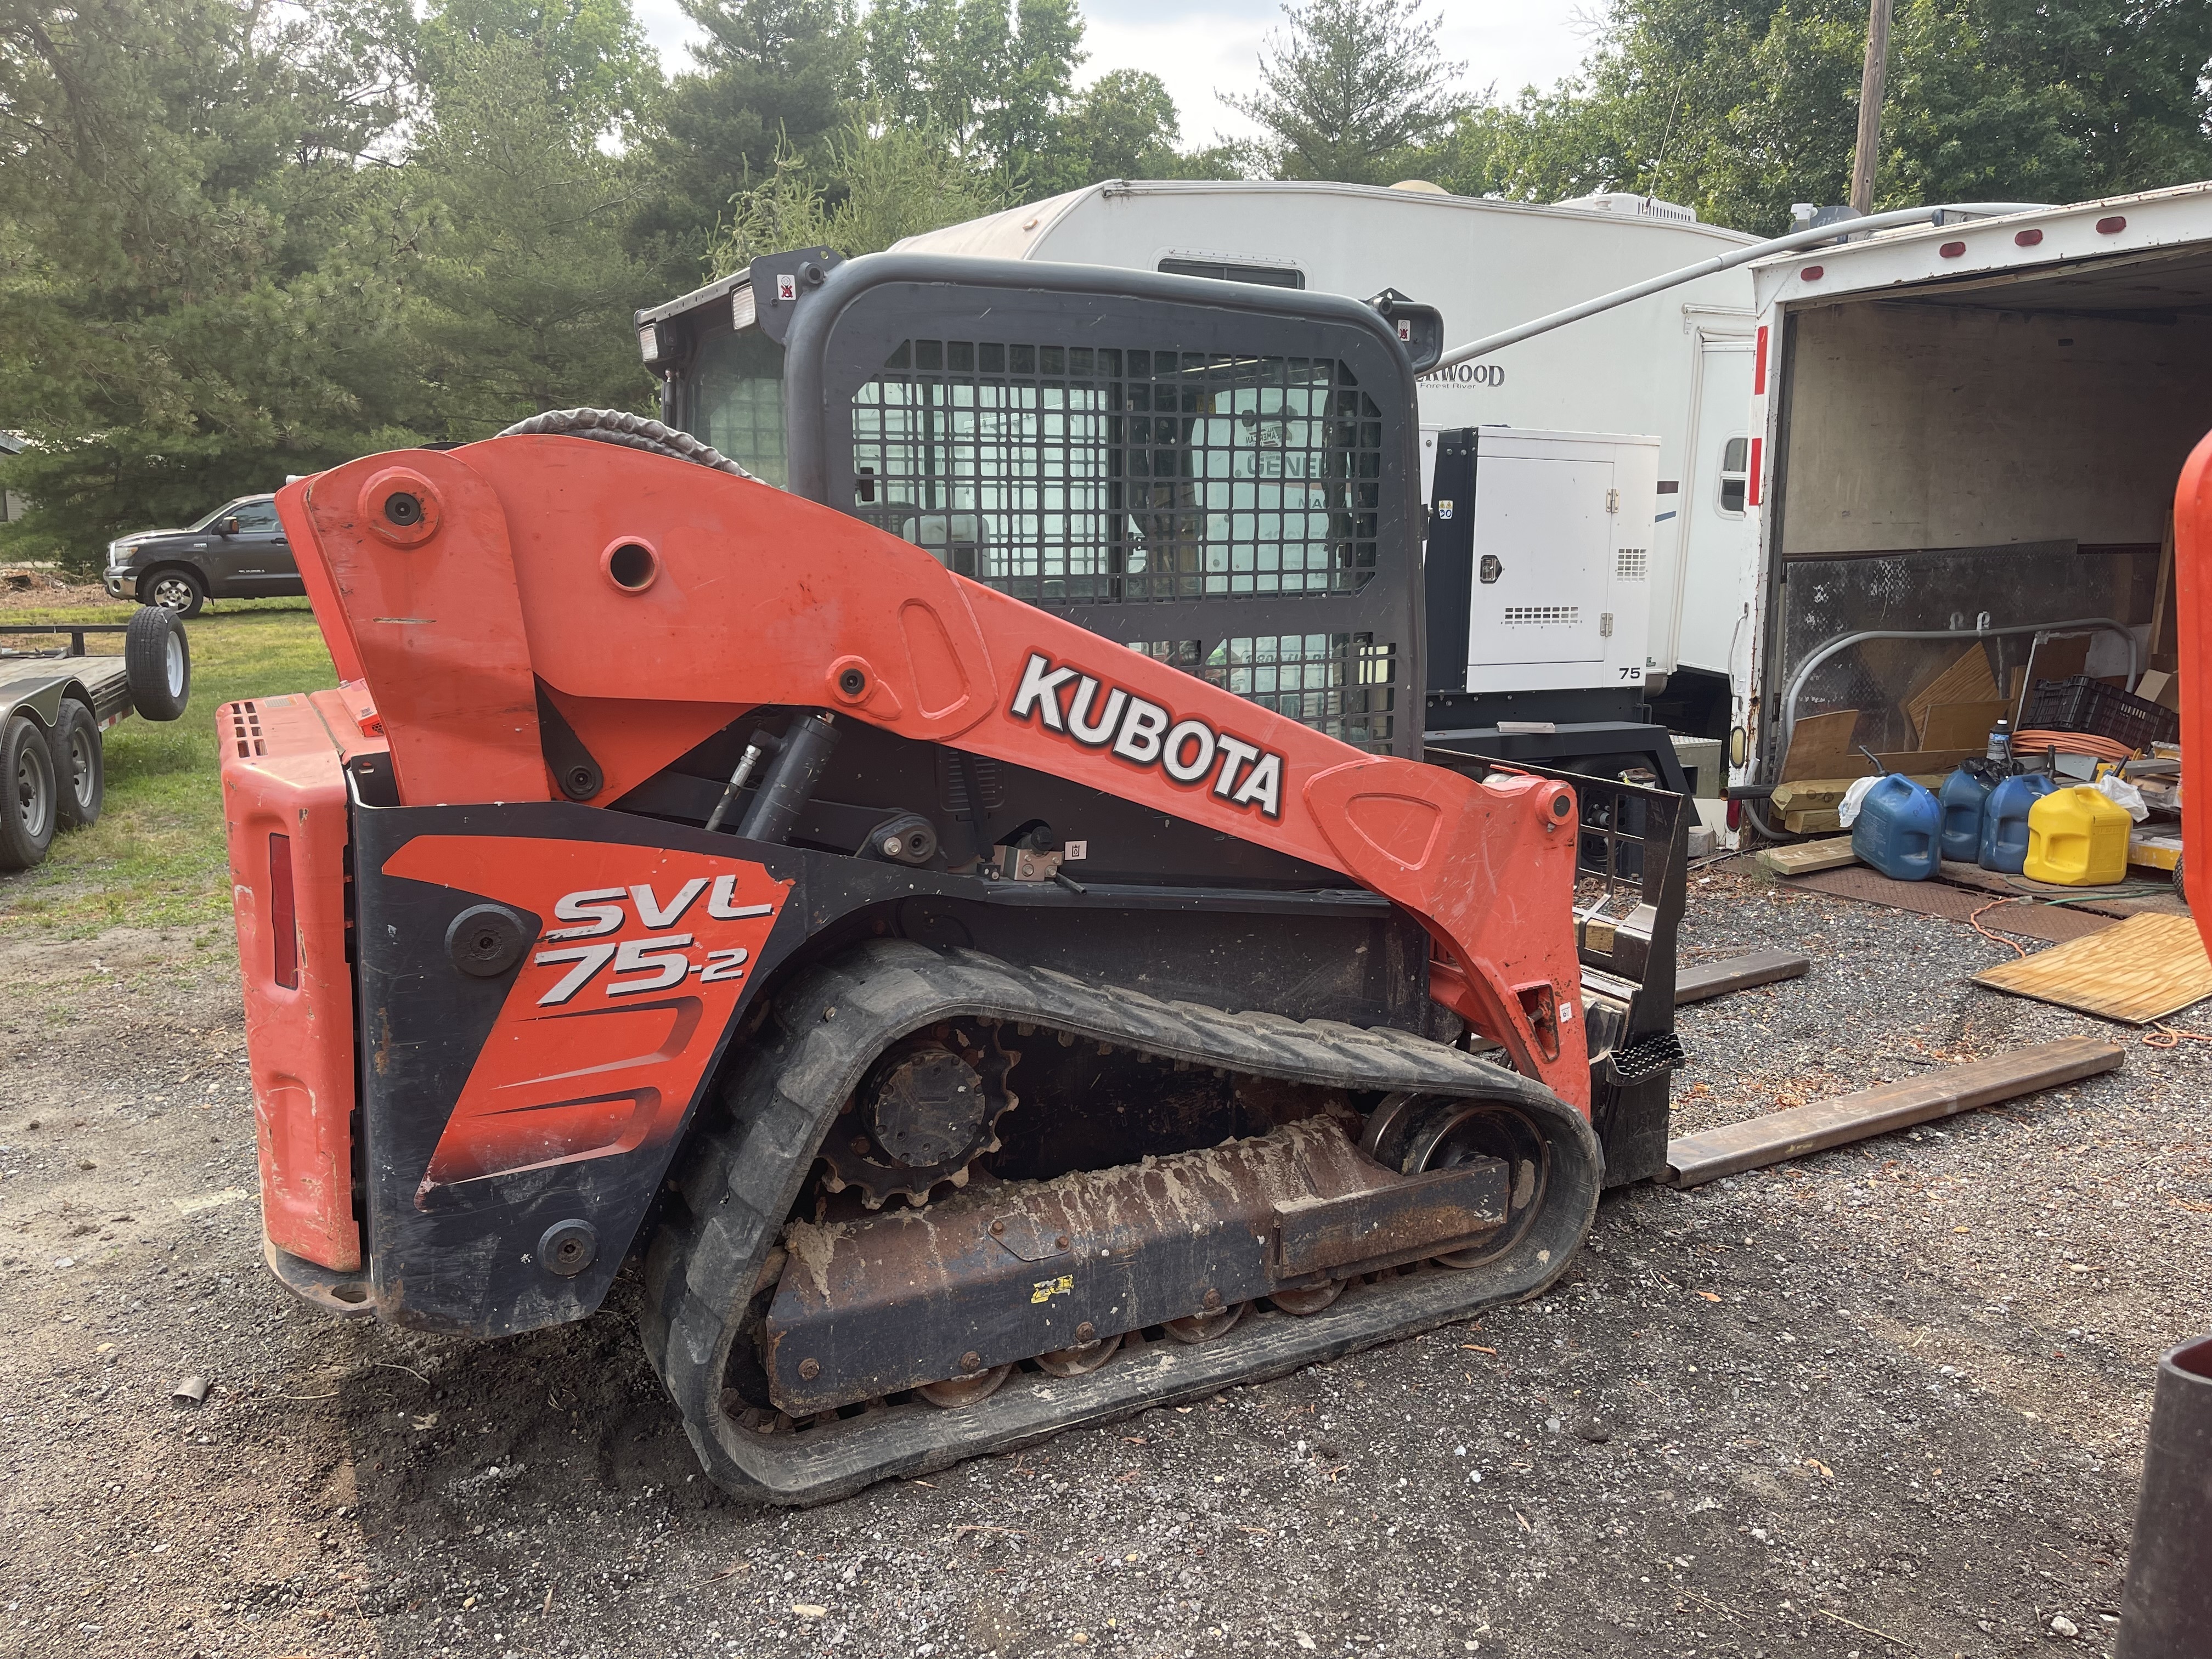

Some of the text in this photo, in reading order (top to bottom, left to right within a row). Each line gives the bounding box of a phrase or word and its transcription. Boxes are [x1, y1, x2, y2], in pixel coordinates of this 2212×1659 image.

[1247, 454, 1322, 478] GENE
[1618, 667, 1640, 680] 75
[1011, 653, 1281, 817] KUBOTA
[545, 874, 774, 943] SVL
[533, 933, 749, 1008] 75-2
